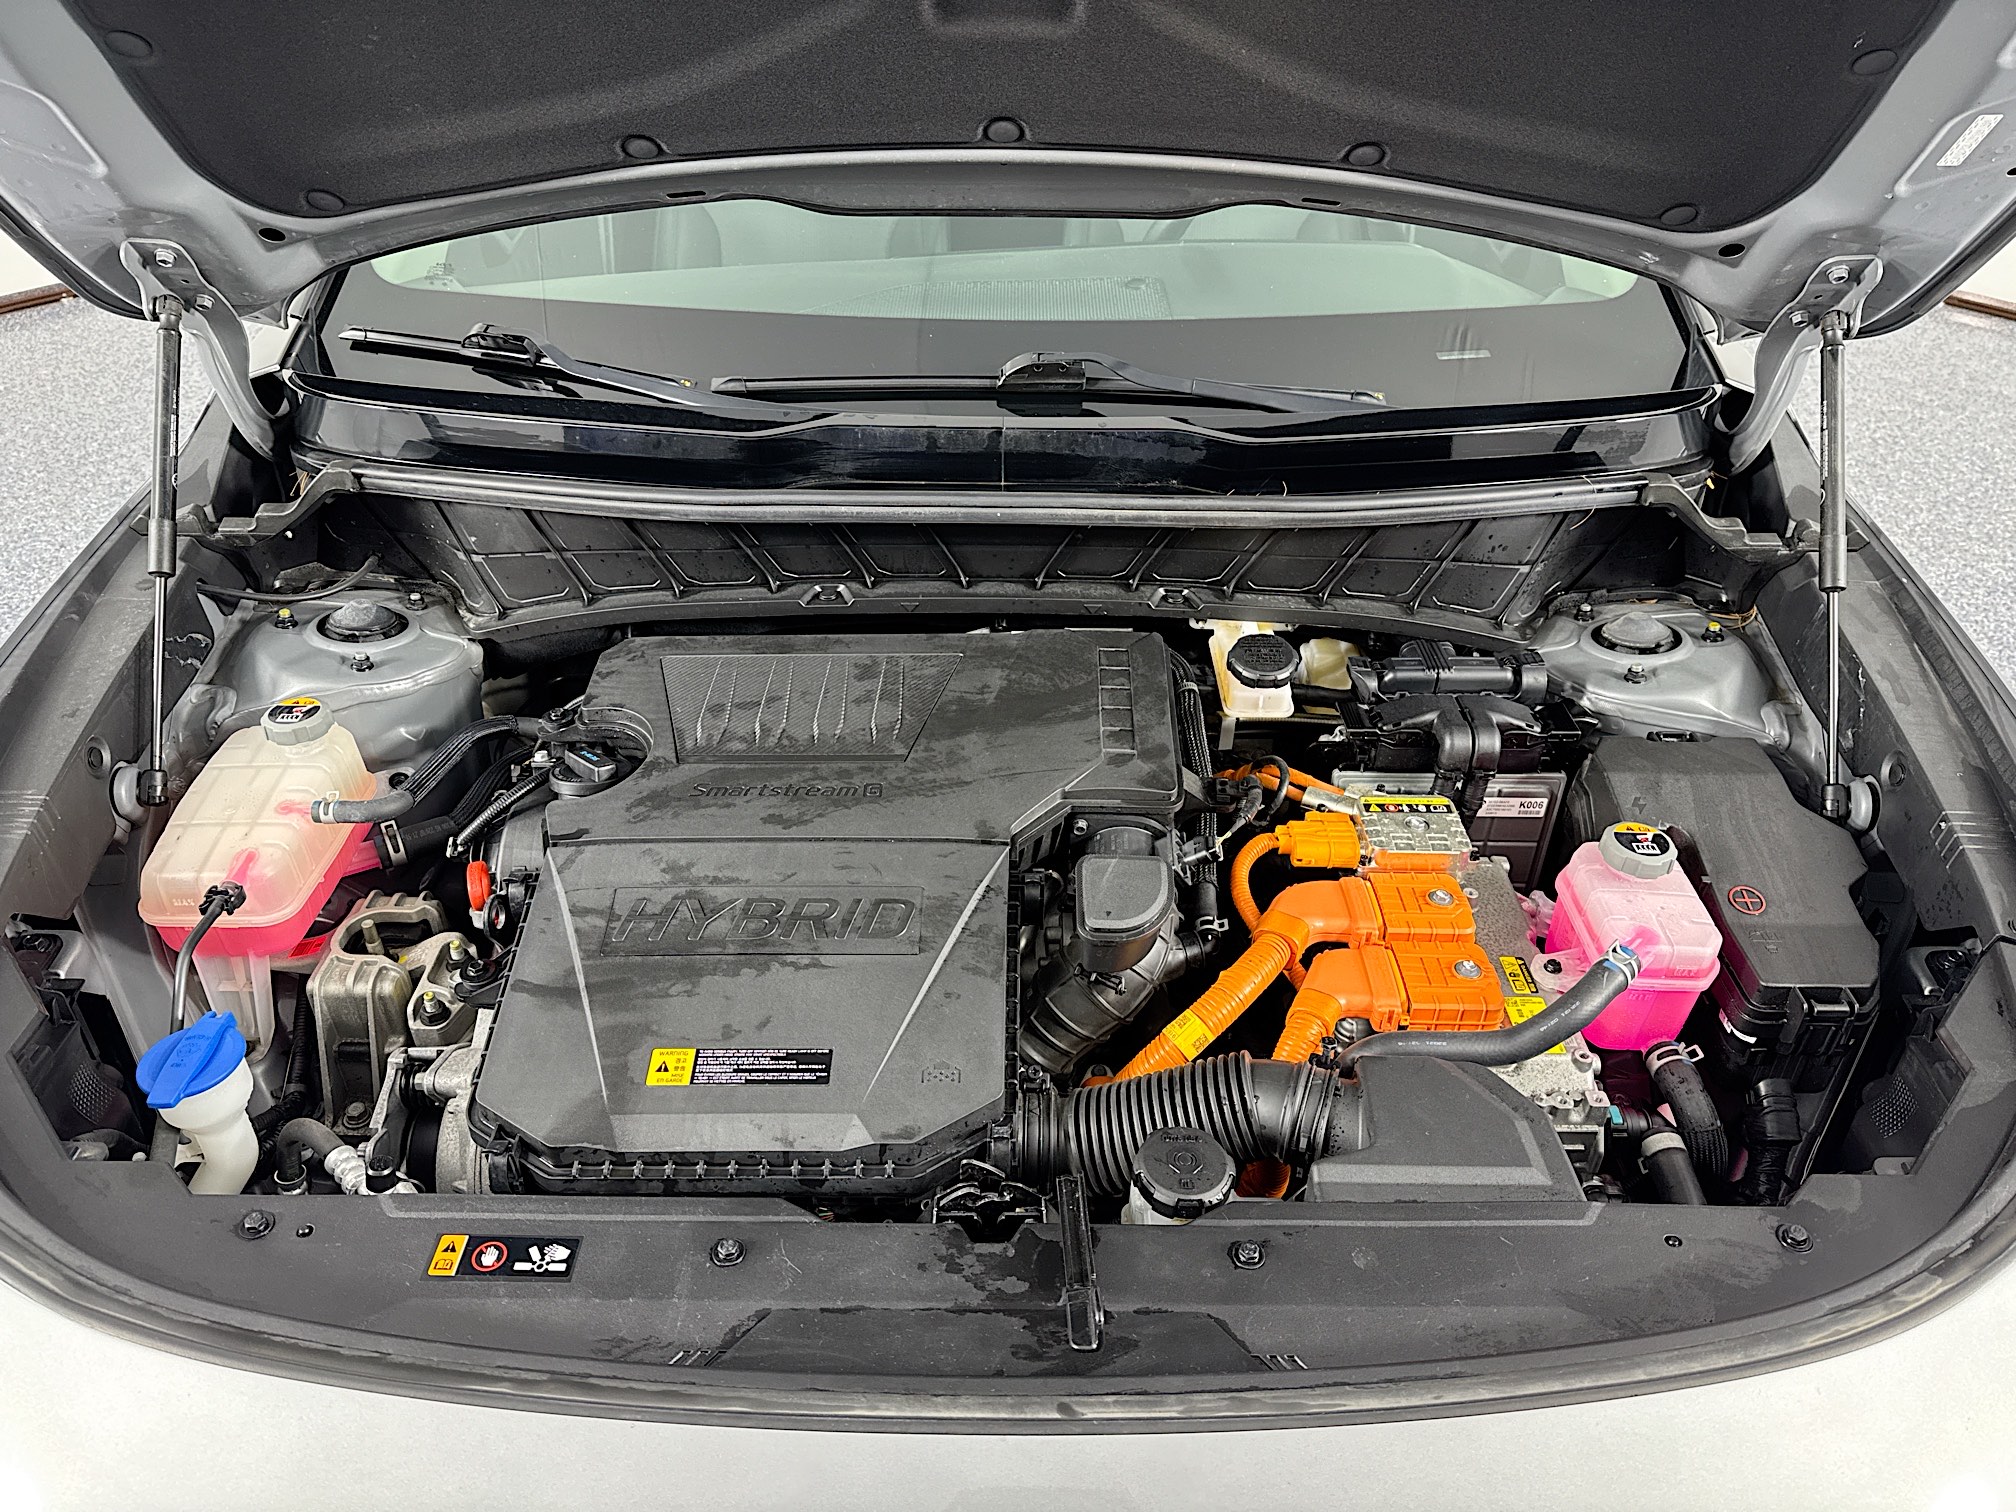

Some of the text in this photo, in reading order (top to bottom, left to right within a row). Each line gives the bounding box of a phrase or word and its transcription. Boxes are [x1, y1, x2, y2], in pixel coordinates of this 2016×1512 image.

[688, 782, 862, 798] Smartstream
[1518, 800, 1544, 810] K006
[612, 897, 917, 942] HYBRID
